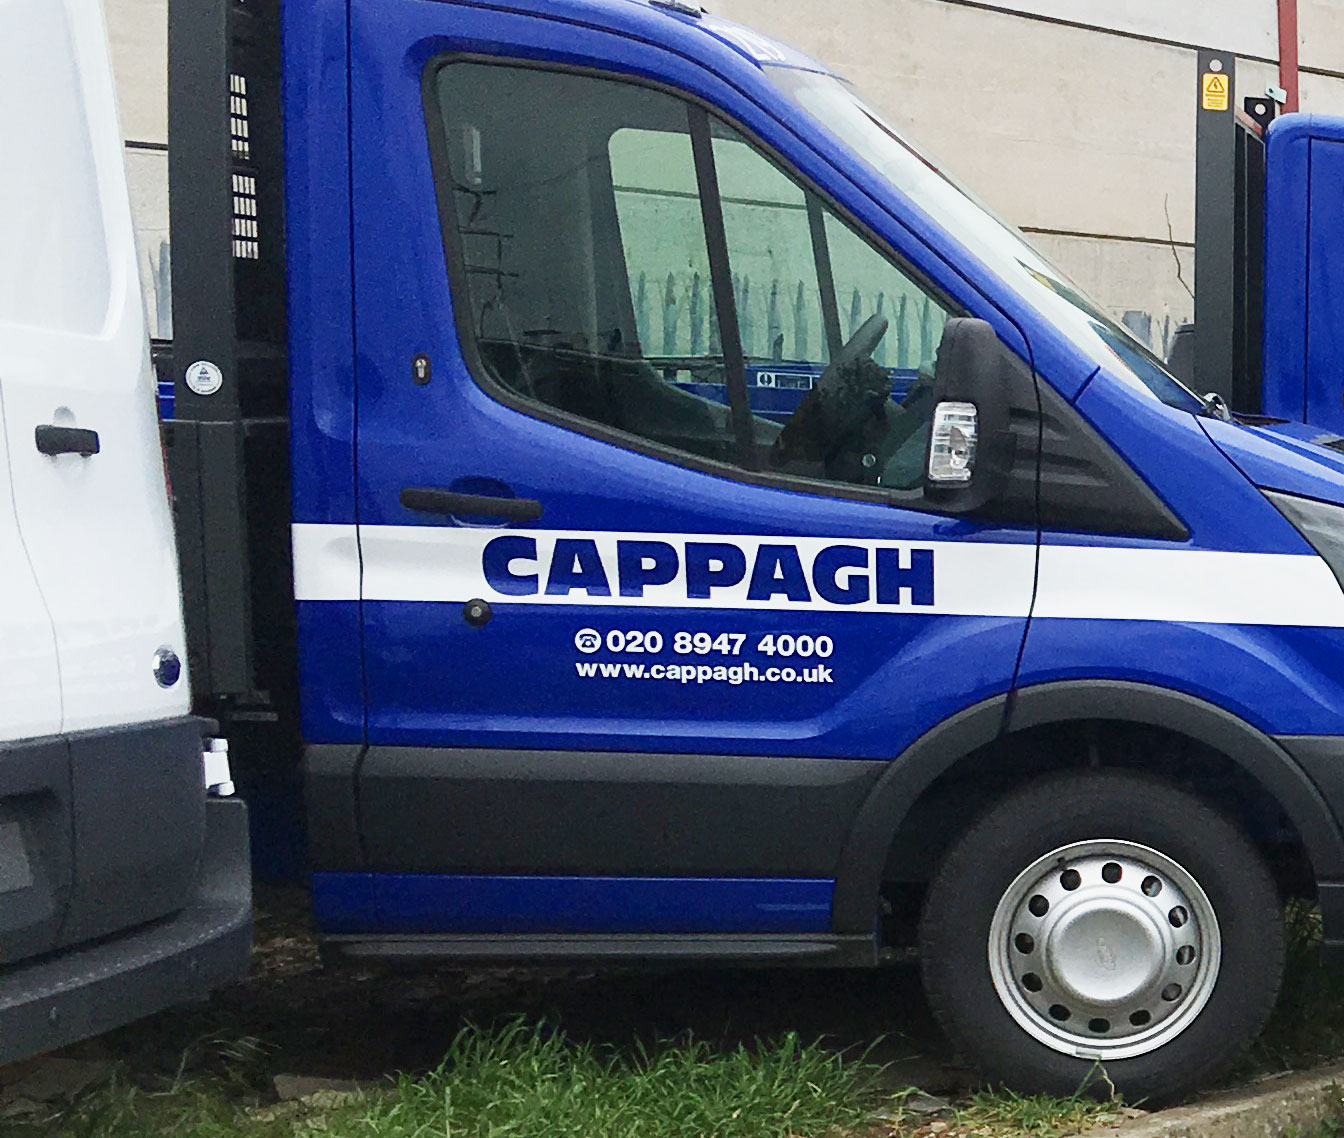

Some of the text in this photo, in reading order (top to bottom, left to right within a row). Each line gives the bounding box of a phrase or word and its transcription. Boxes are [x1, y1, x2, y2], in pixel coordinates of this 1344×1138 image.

[482, 535, 935, 606] CAPPAGH
[606, 629, 834, 658] 020 8947 4000
[576, 660, 834, 685] www.cappagh.co.uk
